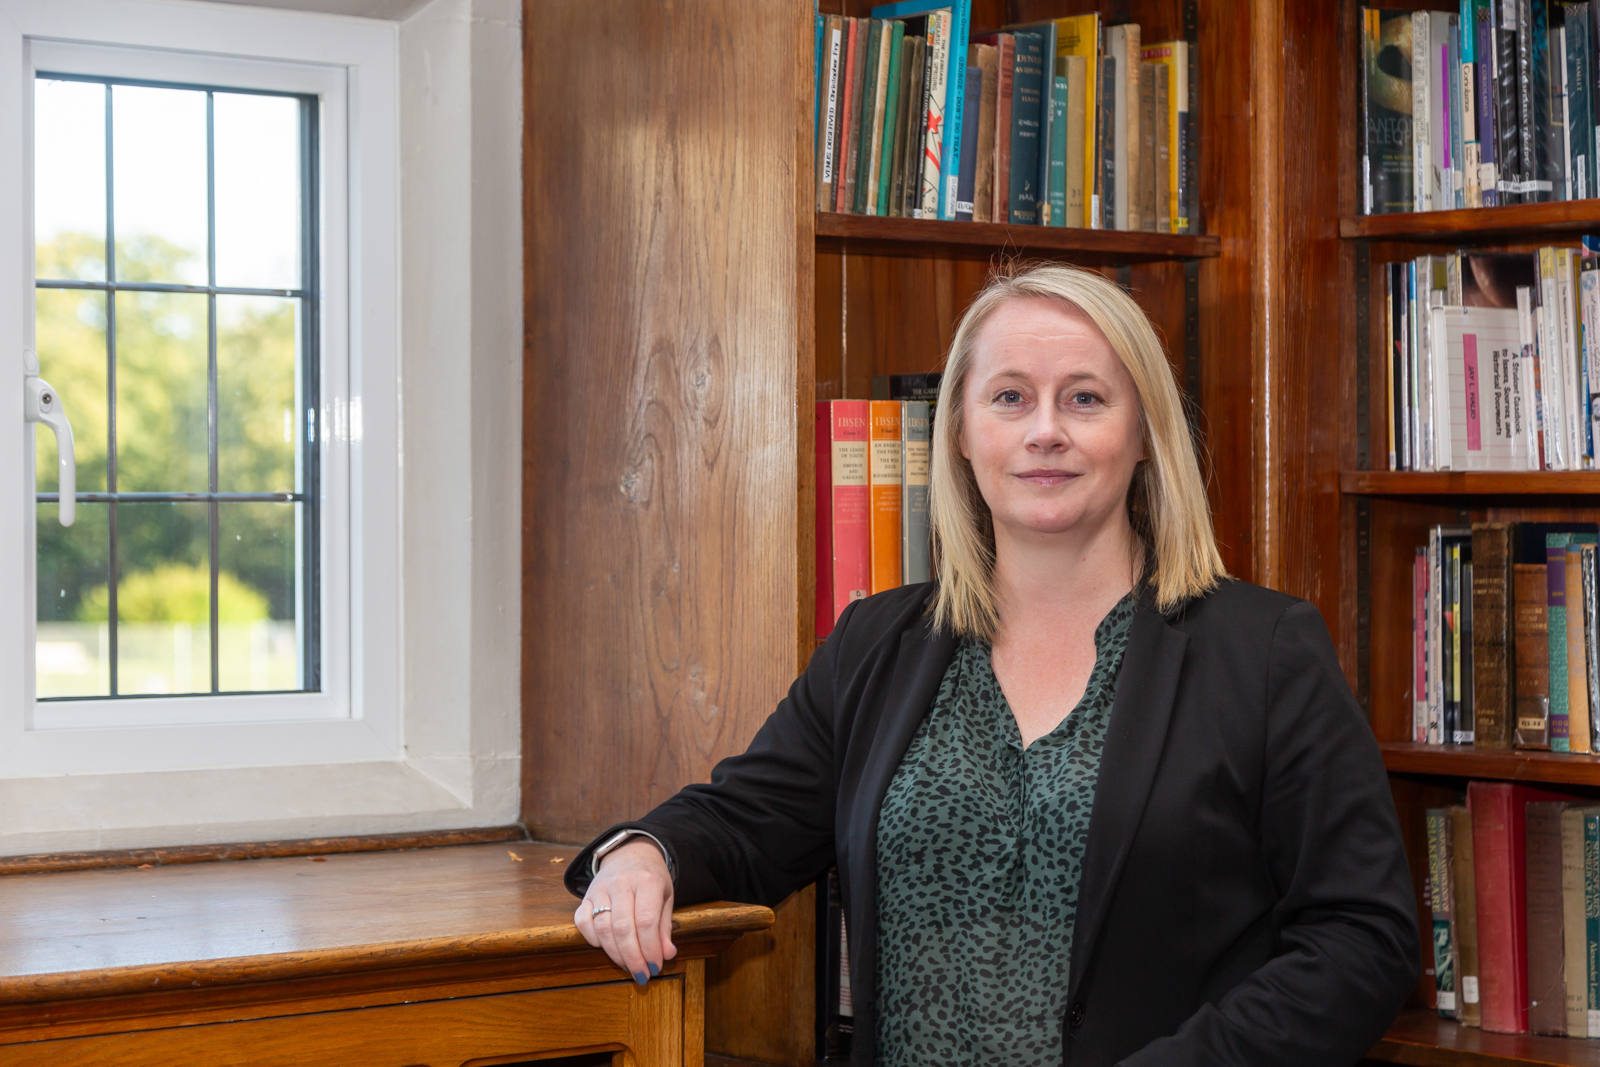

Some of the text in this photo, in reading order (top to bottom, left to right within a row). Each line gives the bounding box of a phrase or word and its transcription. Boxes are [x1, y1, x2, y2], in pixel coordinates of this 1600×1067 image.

[957, 56, 965, 89] GEORGE
[954, 121, 961, 134] DO
[1368, 129, 1412, 145] CLEOP
[1502, 348, 1508, 357] to
[838, 417, 865, 427] IBSEN
[875, 416, 901, 427] IBSEN
[908, 417, 929, 428] IBSEN
[1427, 816, 1441, 913] SHAKESPEARE
[1589, 940, 1598, 982] Alexander
